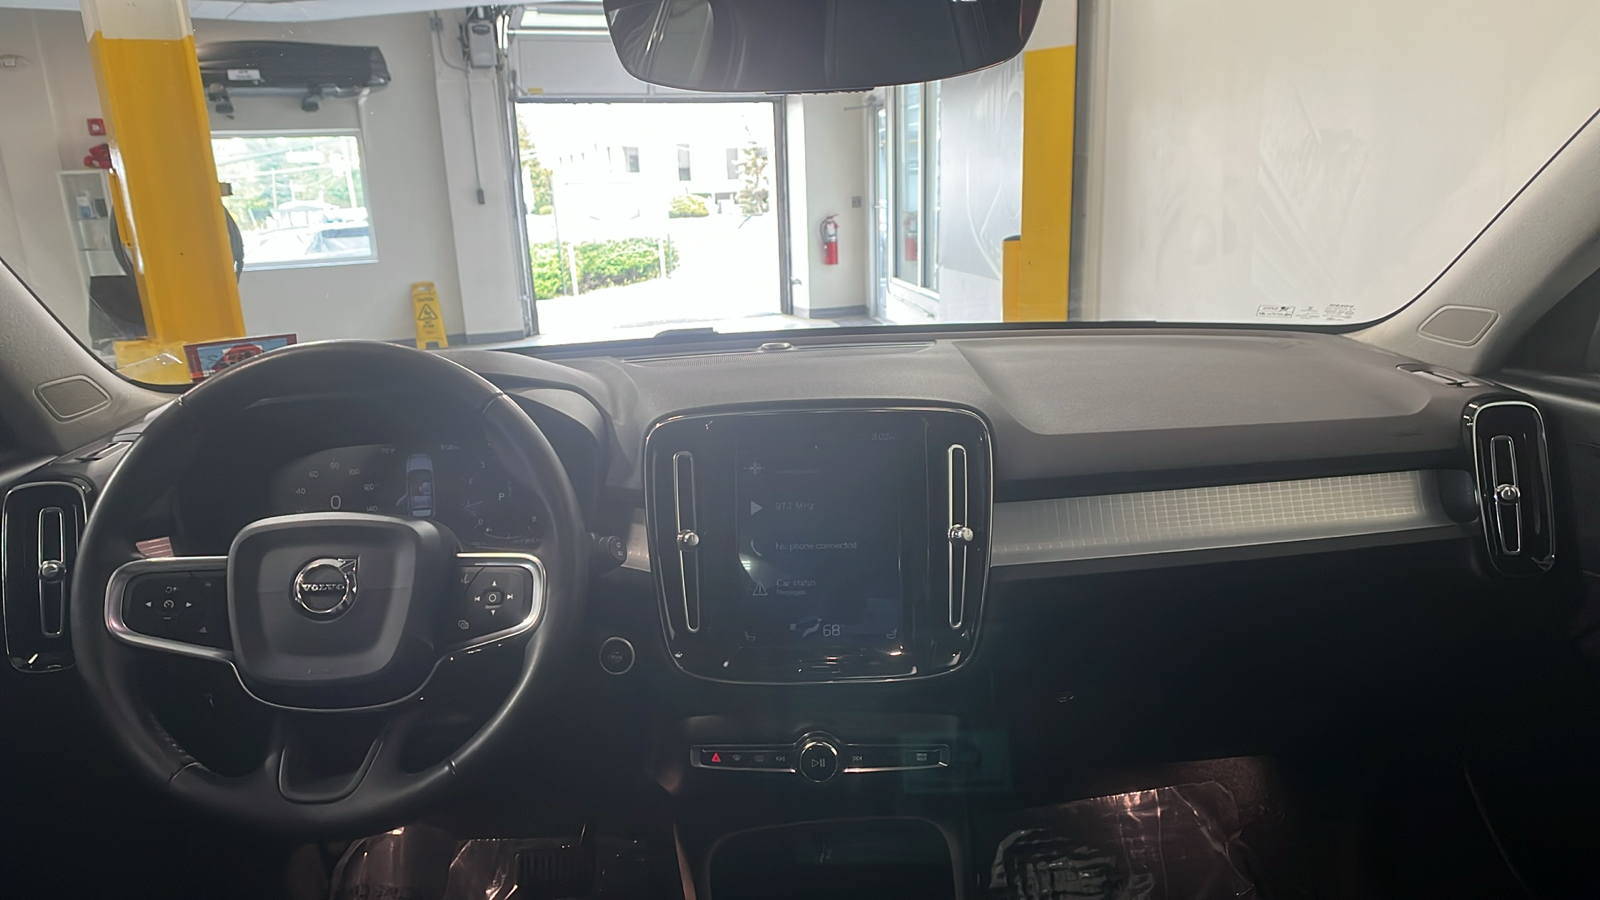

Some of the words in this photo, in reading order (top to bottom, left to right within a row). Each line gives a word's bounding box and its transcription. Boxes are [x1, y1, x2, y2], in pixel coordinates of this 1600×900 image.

[295, 487, 306, 495] 40
[498, 492, 505, 501] P
[330, 495, 341, 510] 0
[789, 542, 814, 552] phone
[815, 541, 857, 550] connected
[776, 578, 790, 587] Car
[792, 579, 817, 587] status
[302, 583, 345, 592] VOLVO
[822, 623, 841, 637] 68
